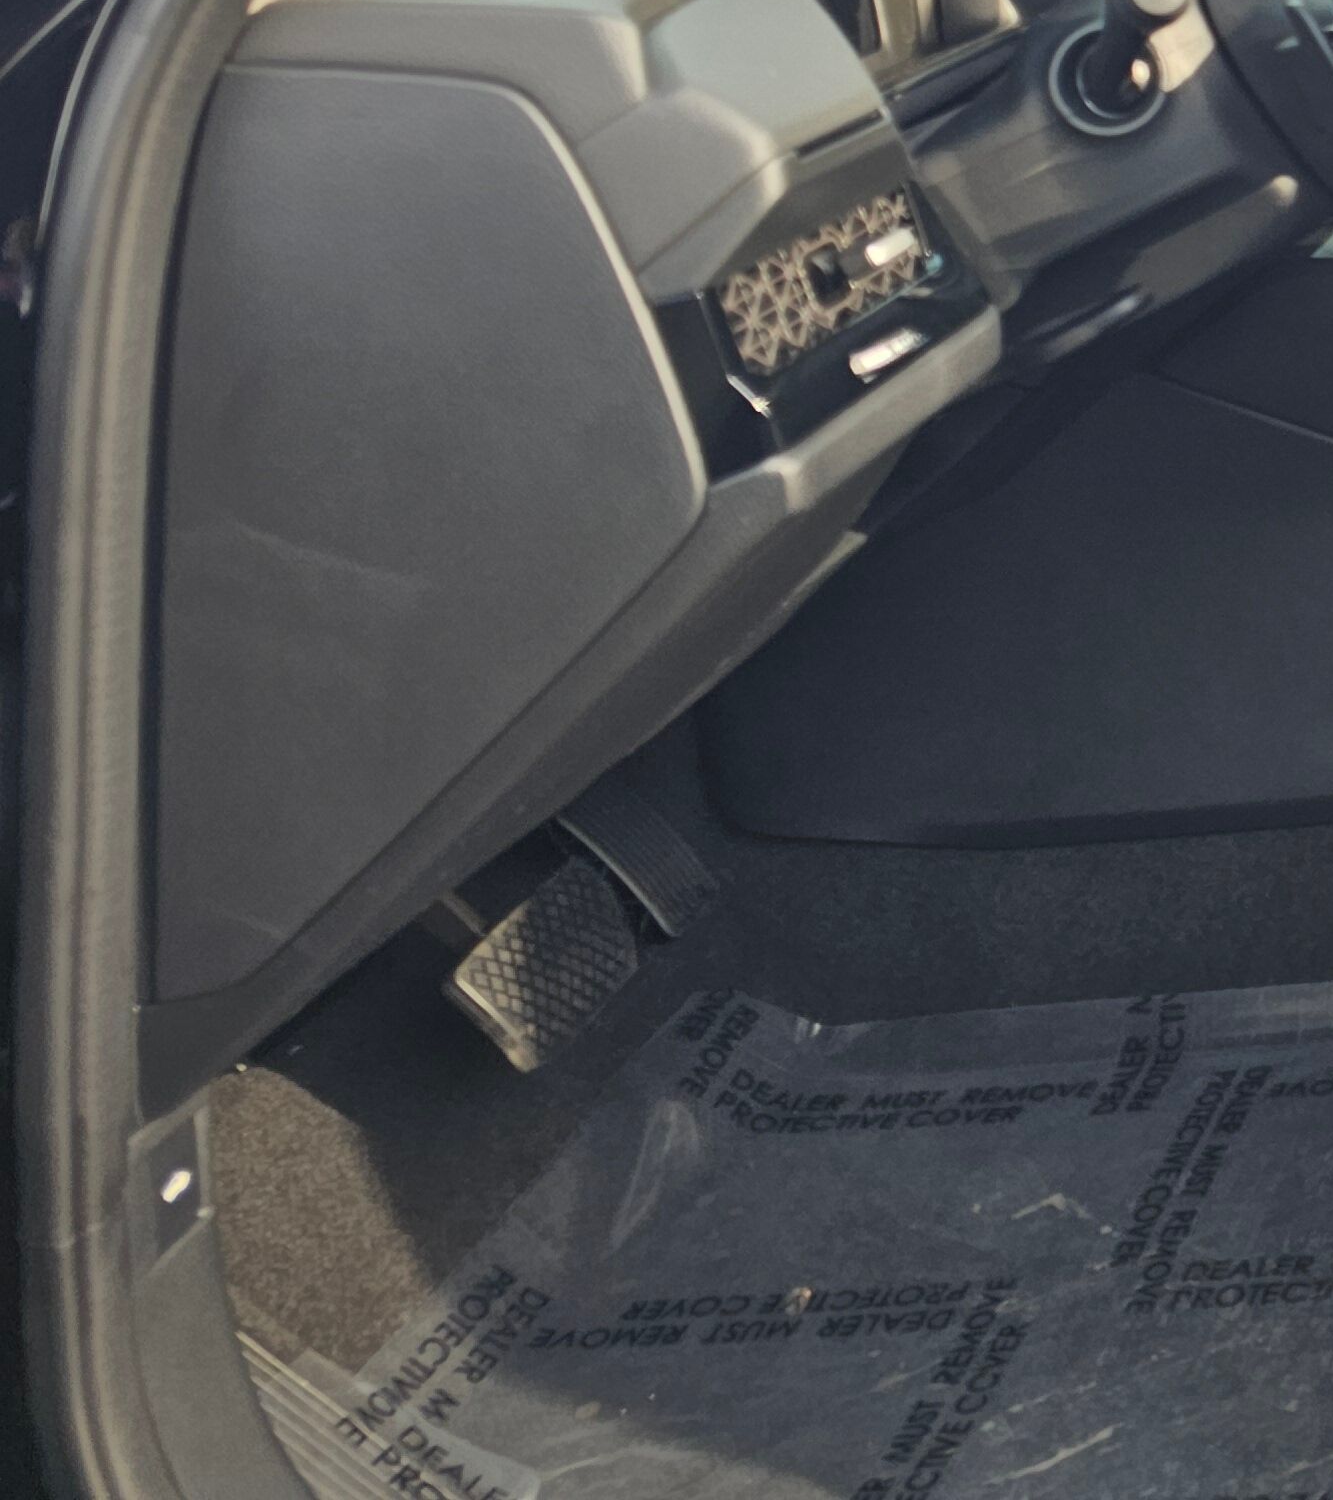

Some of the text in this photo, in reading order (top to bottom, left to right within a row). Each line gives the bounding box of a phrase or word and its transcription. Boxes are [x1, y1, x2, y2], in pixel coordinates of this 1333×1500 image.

[957, 1080, 1100, 1105] REMOVE
[1182, 1254, 1316, 1282] DEALER
[526, 1323, 691, 1351] REMOVE
[816, 1307, 958, 1339] DEALER
